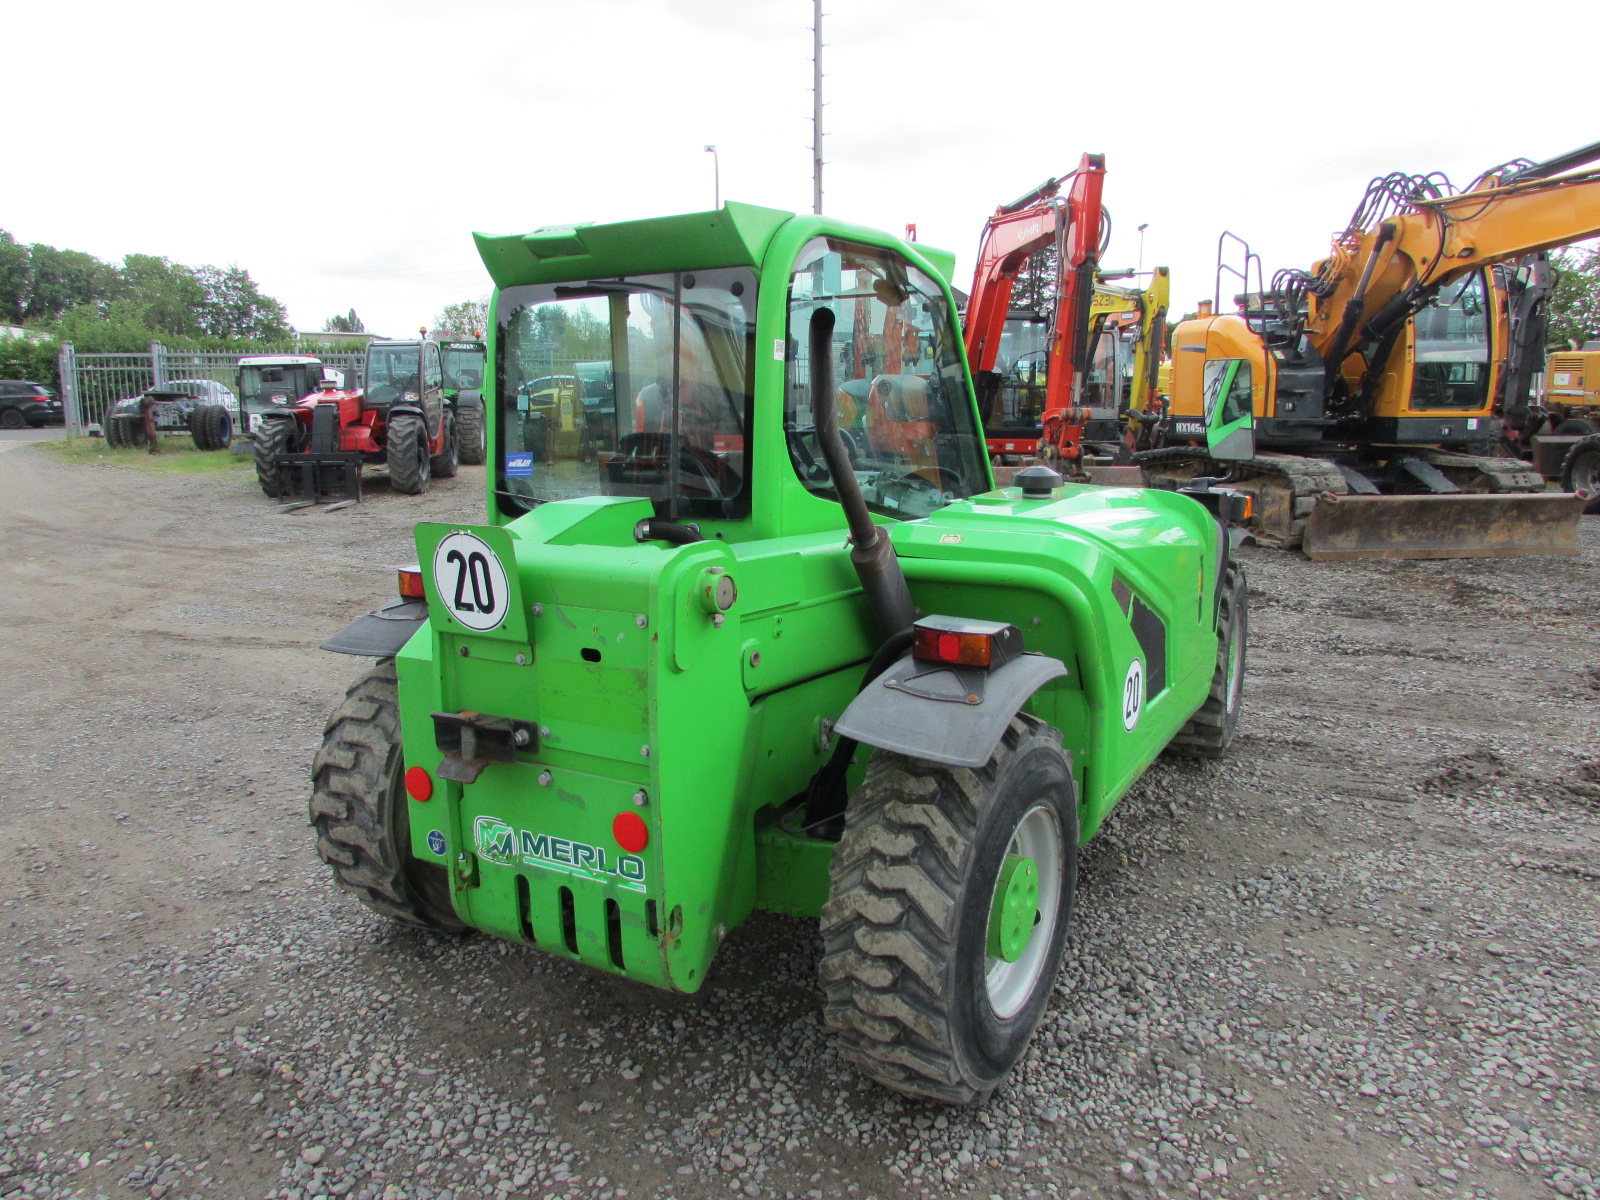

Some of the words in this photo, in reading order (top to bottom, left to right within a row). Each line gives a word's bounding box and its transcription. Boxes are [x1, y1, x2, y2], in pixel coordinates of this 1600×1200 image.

[446, 549, 496, 615] 20
[1126, 671, 1140, 720] 20
[520, 829, 646, 882] MERLO
